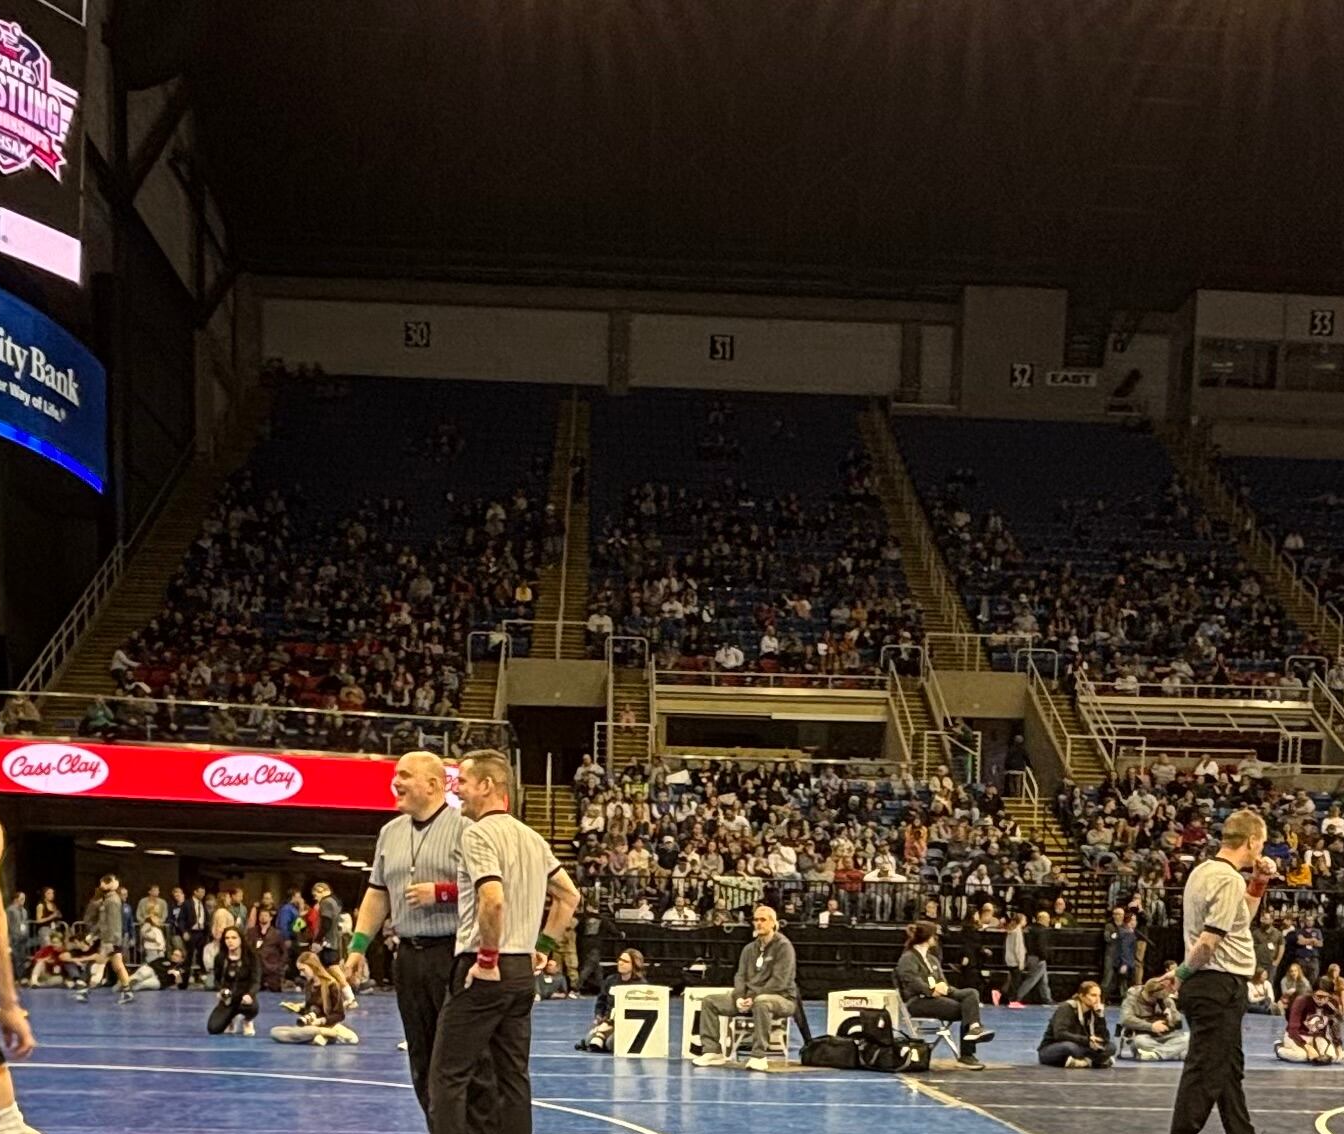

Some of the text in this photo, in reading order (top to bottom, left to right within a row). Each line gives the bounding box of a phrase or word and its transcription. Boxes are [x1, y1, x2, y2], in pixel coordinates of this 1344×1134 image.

[405, 322, 430, 348] 30
[1312, 311, 1332, 336] 33
[711, 334, 734, 360] 31
[29, 346, 80, 408] Bank
[1012, 363, 1032, 388] 32
[1050, 373, 1091, 385] EAST
[9, 382, 31, 407] Way
[31, 394, 43, 411] of
[9, 753, 101, 779] Cass-Clay
[209, 764, 295, 789] Cass-Clay
[624, 1009, 659, 1054] 7
